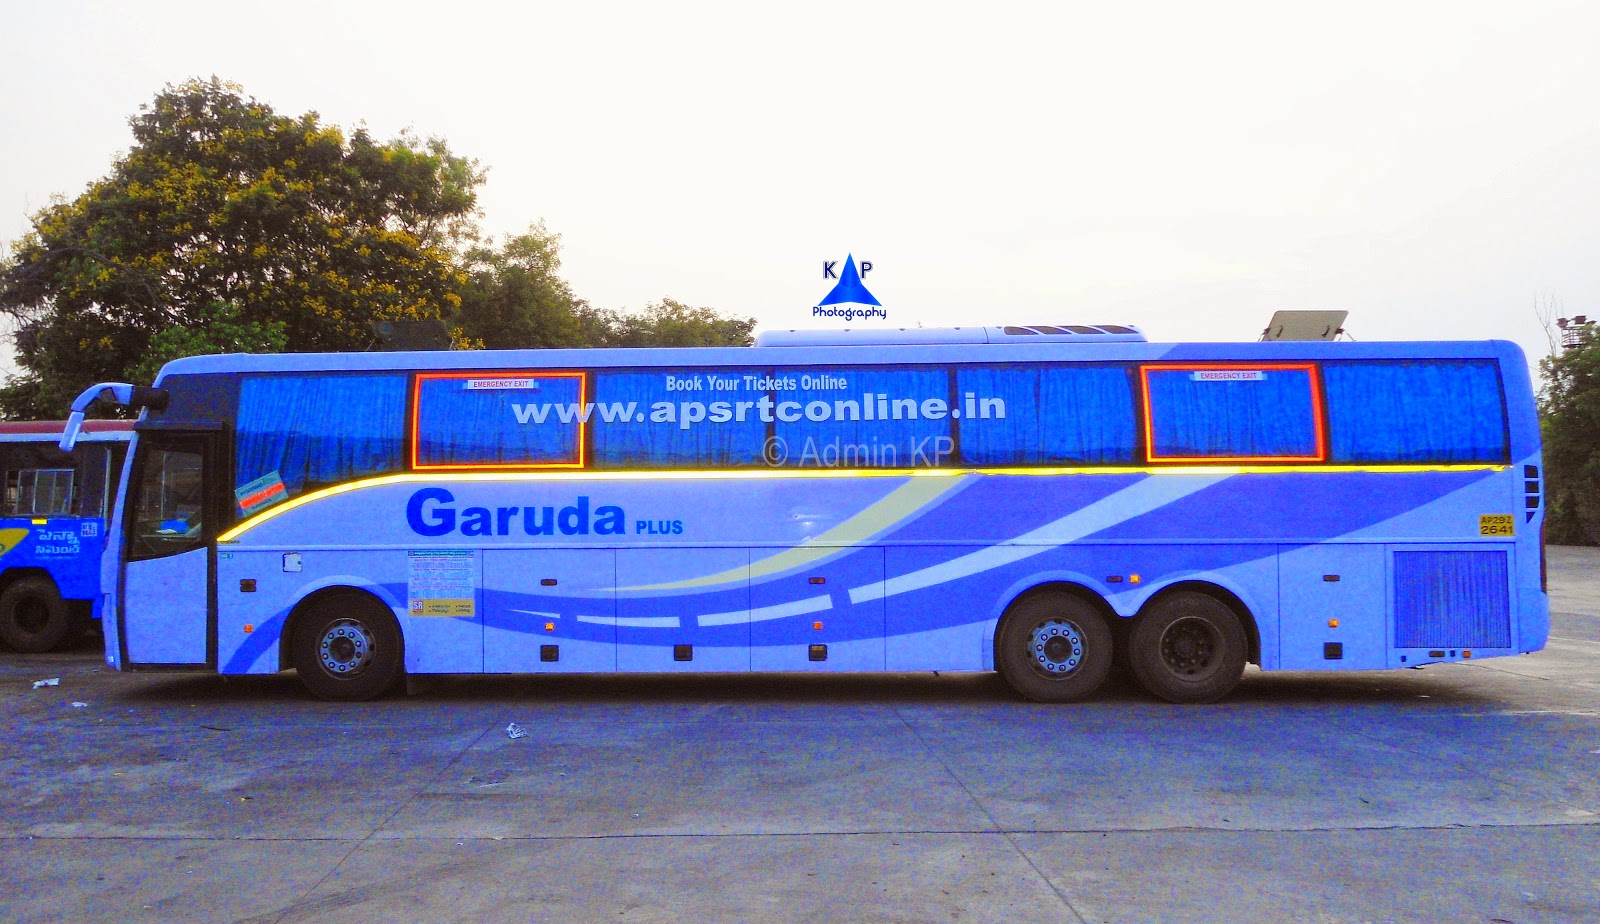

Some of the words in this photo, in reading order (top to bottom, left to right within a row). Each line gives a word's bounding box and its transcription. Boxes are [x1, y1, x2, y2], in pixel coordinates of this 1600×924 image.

[666, 375, 703, 391] Book
[706, 375, 740, 391] Your
[743, 375, 797, 391] Tickets
[801, 374, 848, 391] Online
[1200, 372, 1240, 380] EMERGENCY
[511, 392, 1006, 430] www.apsrtconline.in
[406, 487, 626, 536] Garuda
[636, 520, 683, 535] PLUS
[1481, 525, 1513, 535] 2641
